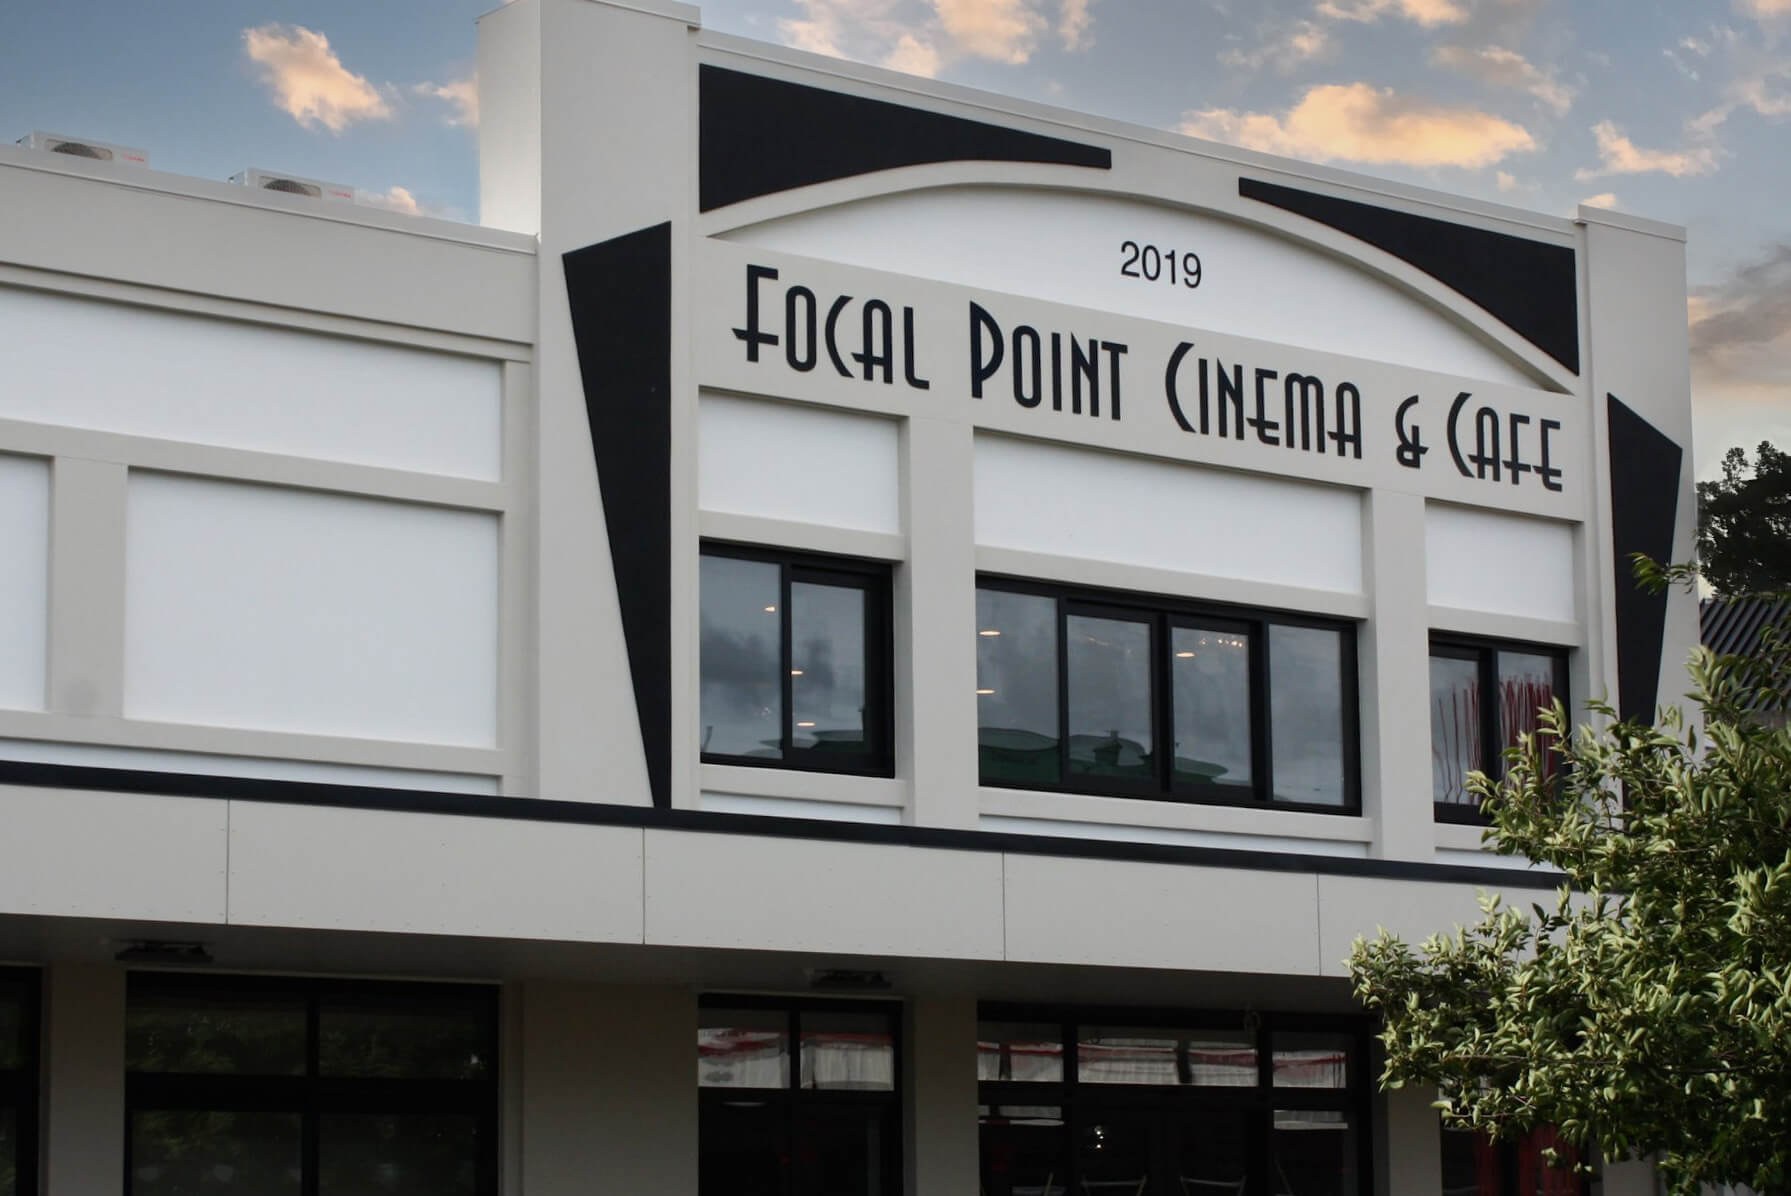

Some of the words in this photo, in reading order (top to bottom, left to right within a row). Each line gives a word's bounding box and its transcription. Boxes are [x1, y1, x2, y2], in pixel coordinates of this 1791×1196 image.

[1120, 239, 1203, 290] 2019
[731, 263, 931, 391] FOCAL
[969, 300, 1129, 421] POINT
[1165, 341, 1363, 460] CINEMA
[1395, 394, 1430, 470] &
[1446, 391, 1563, 493] CAFE
